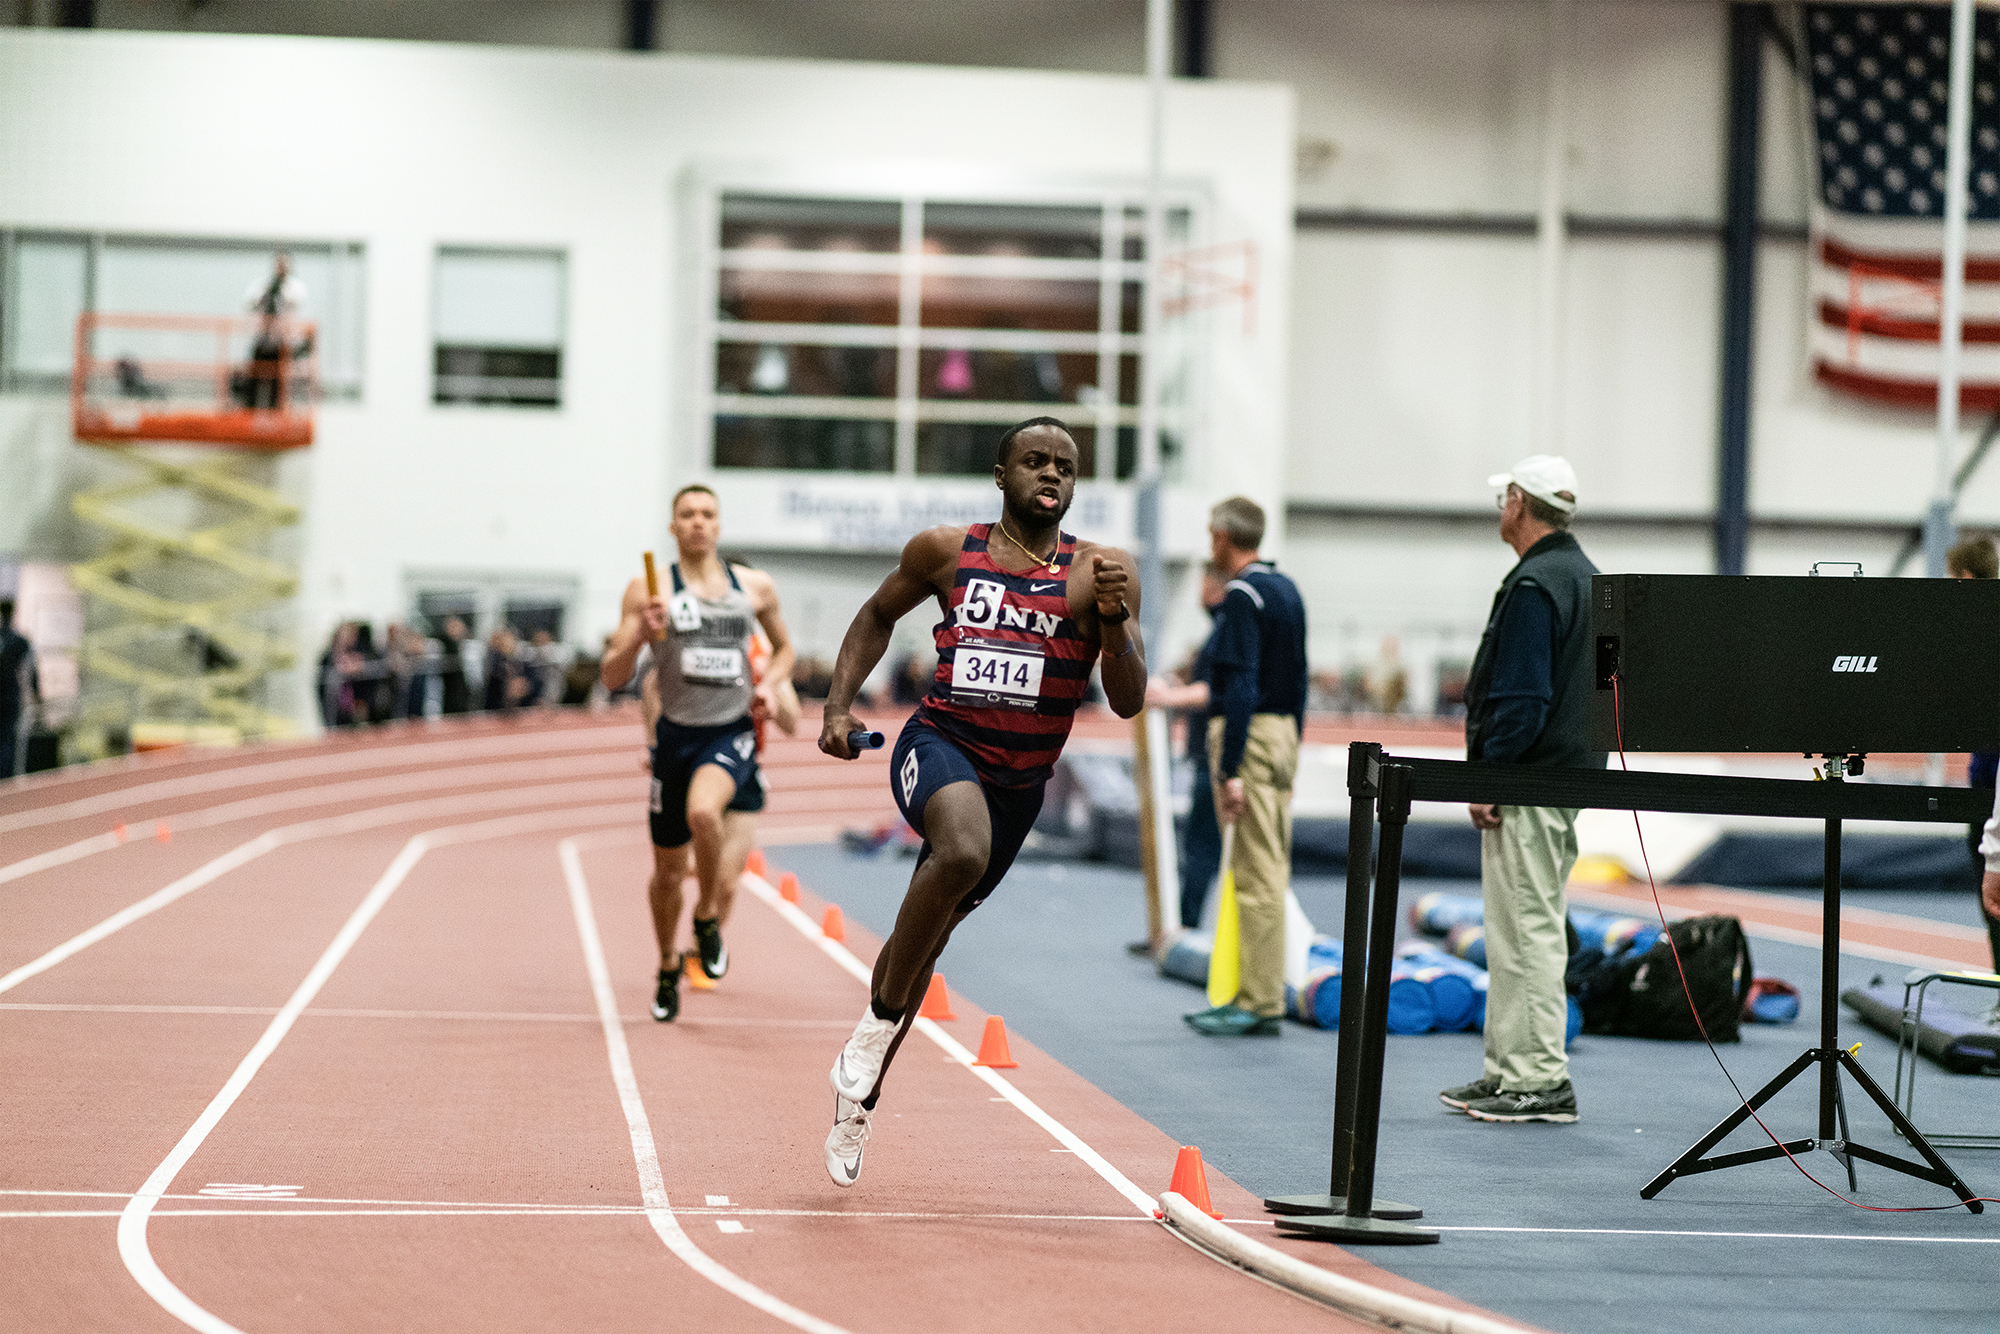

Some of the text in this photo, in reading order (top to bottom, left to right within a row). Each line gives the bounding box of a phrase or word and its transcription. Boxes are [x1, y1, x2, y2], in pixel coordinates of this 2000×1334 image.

[966, 582, 998, 624] 5
[966, 657, 1029, 688] 3414
[1832, 655, 1878, 673] GILL
[903, 755, 915, 798] 5
